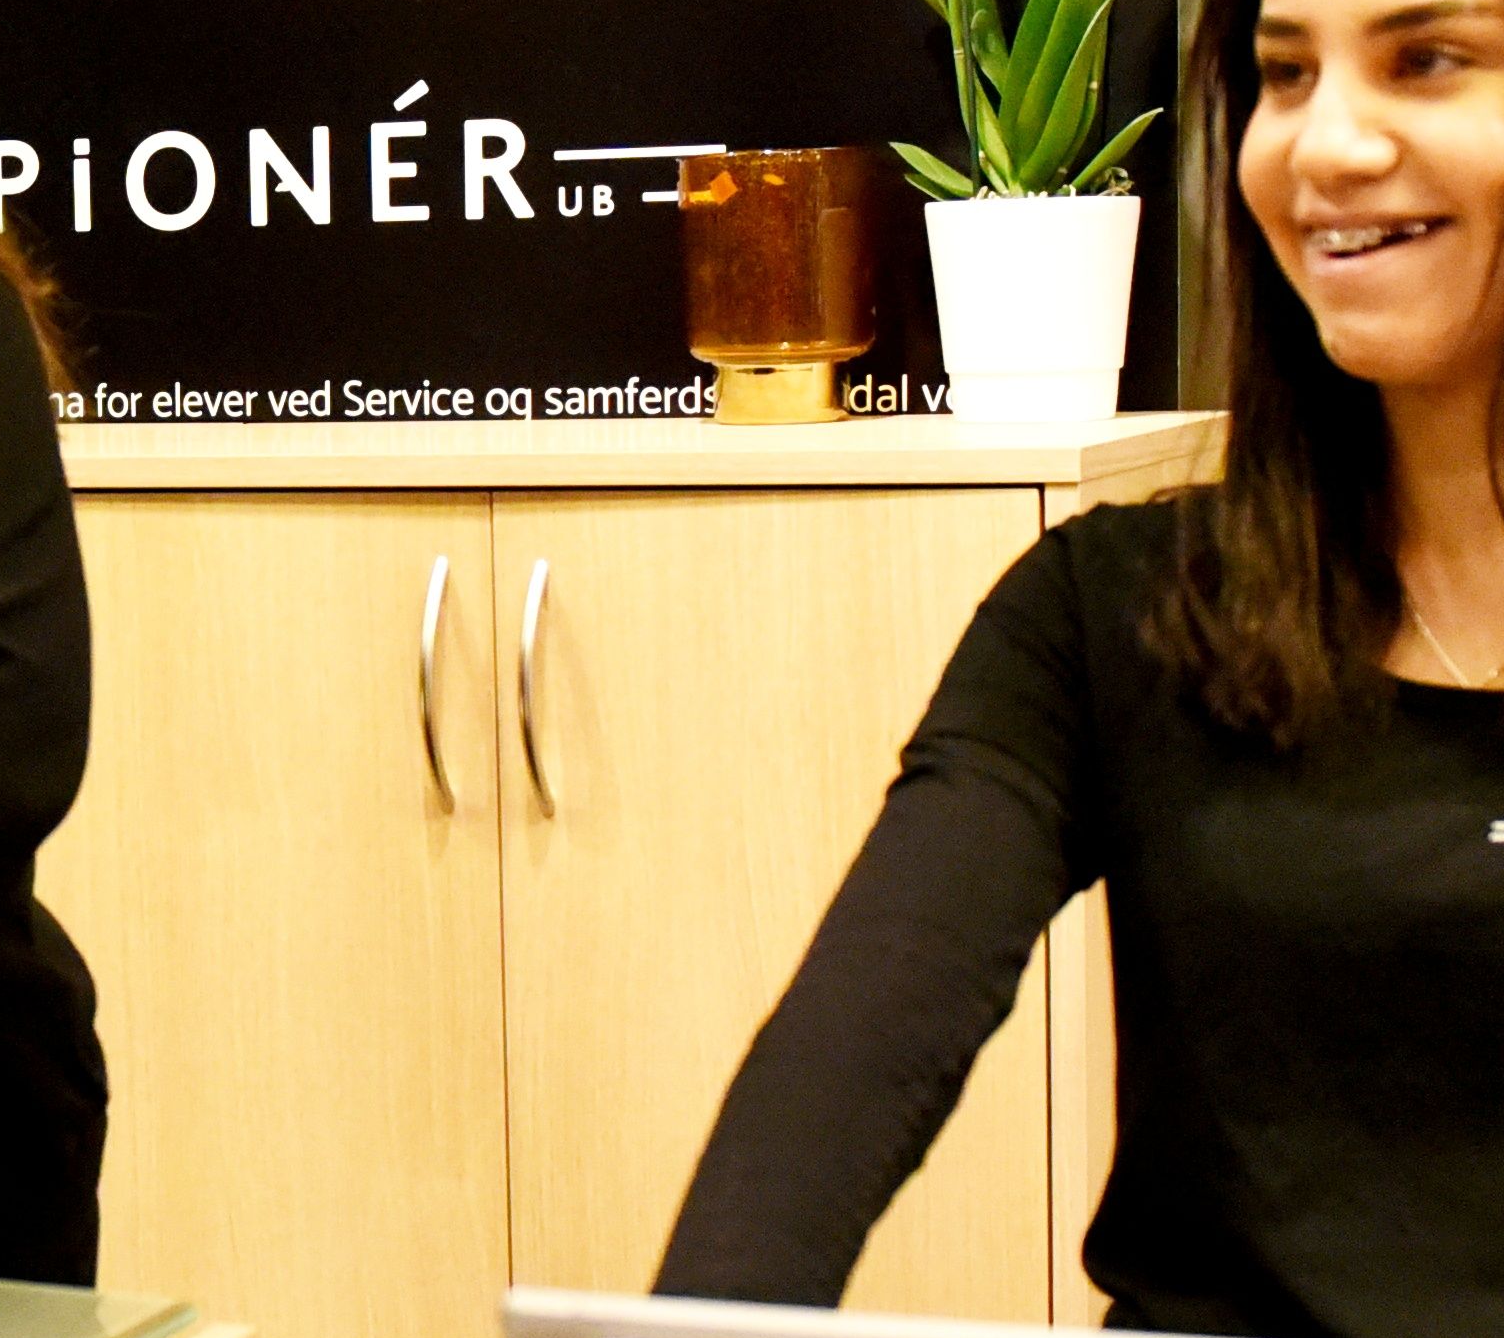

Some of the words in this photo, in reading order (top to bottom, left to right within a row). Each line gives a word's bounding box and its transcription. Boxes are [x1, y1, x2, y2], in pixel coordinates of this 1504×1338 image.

[557, 184, 616, 218] UB
[94, 382, 143, 418] for
[152, 381, 259, 418] elever
[267, 379, 331, 417] ved
[343, 379, 475, 417] Service
[841, 373, 909, 413] dal
